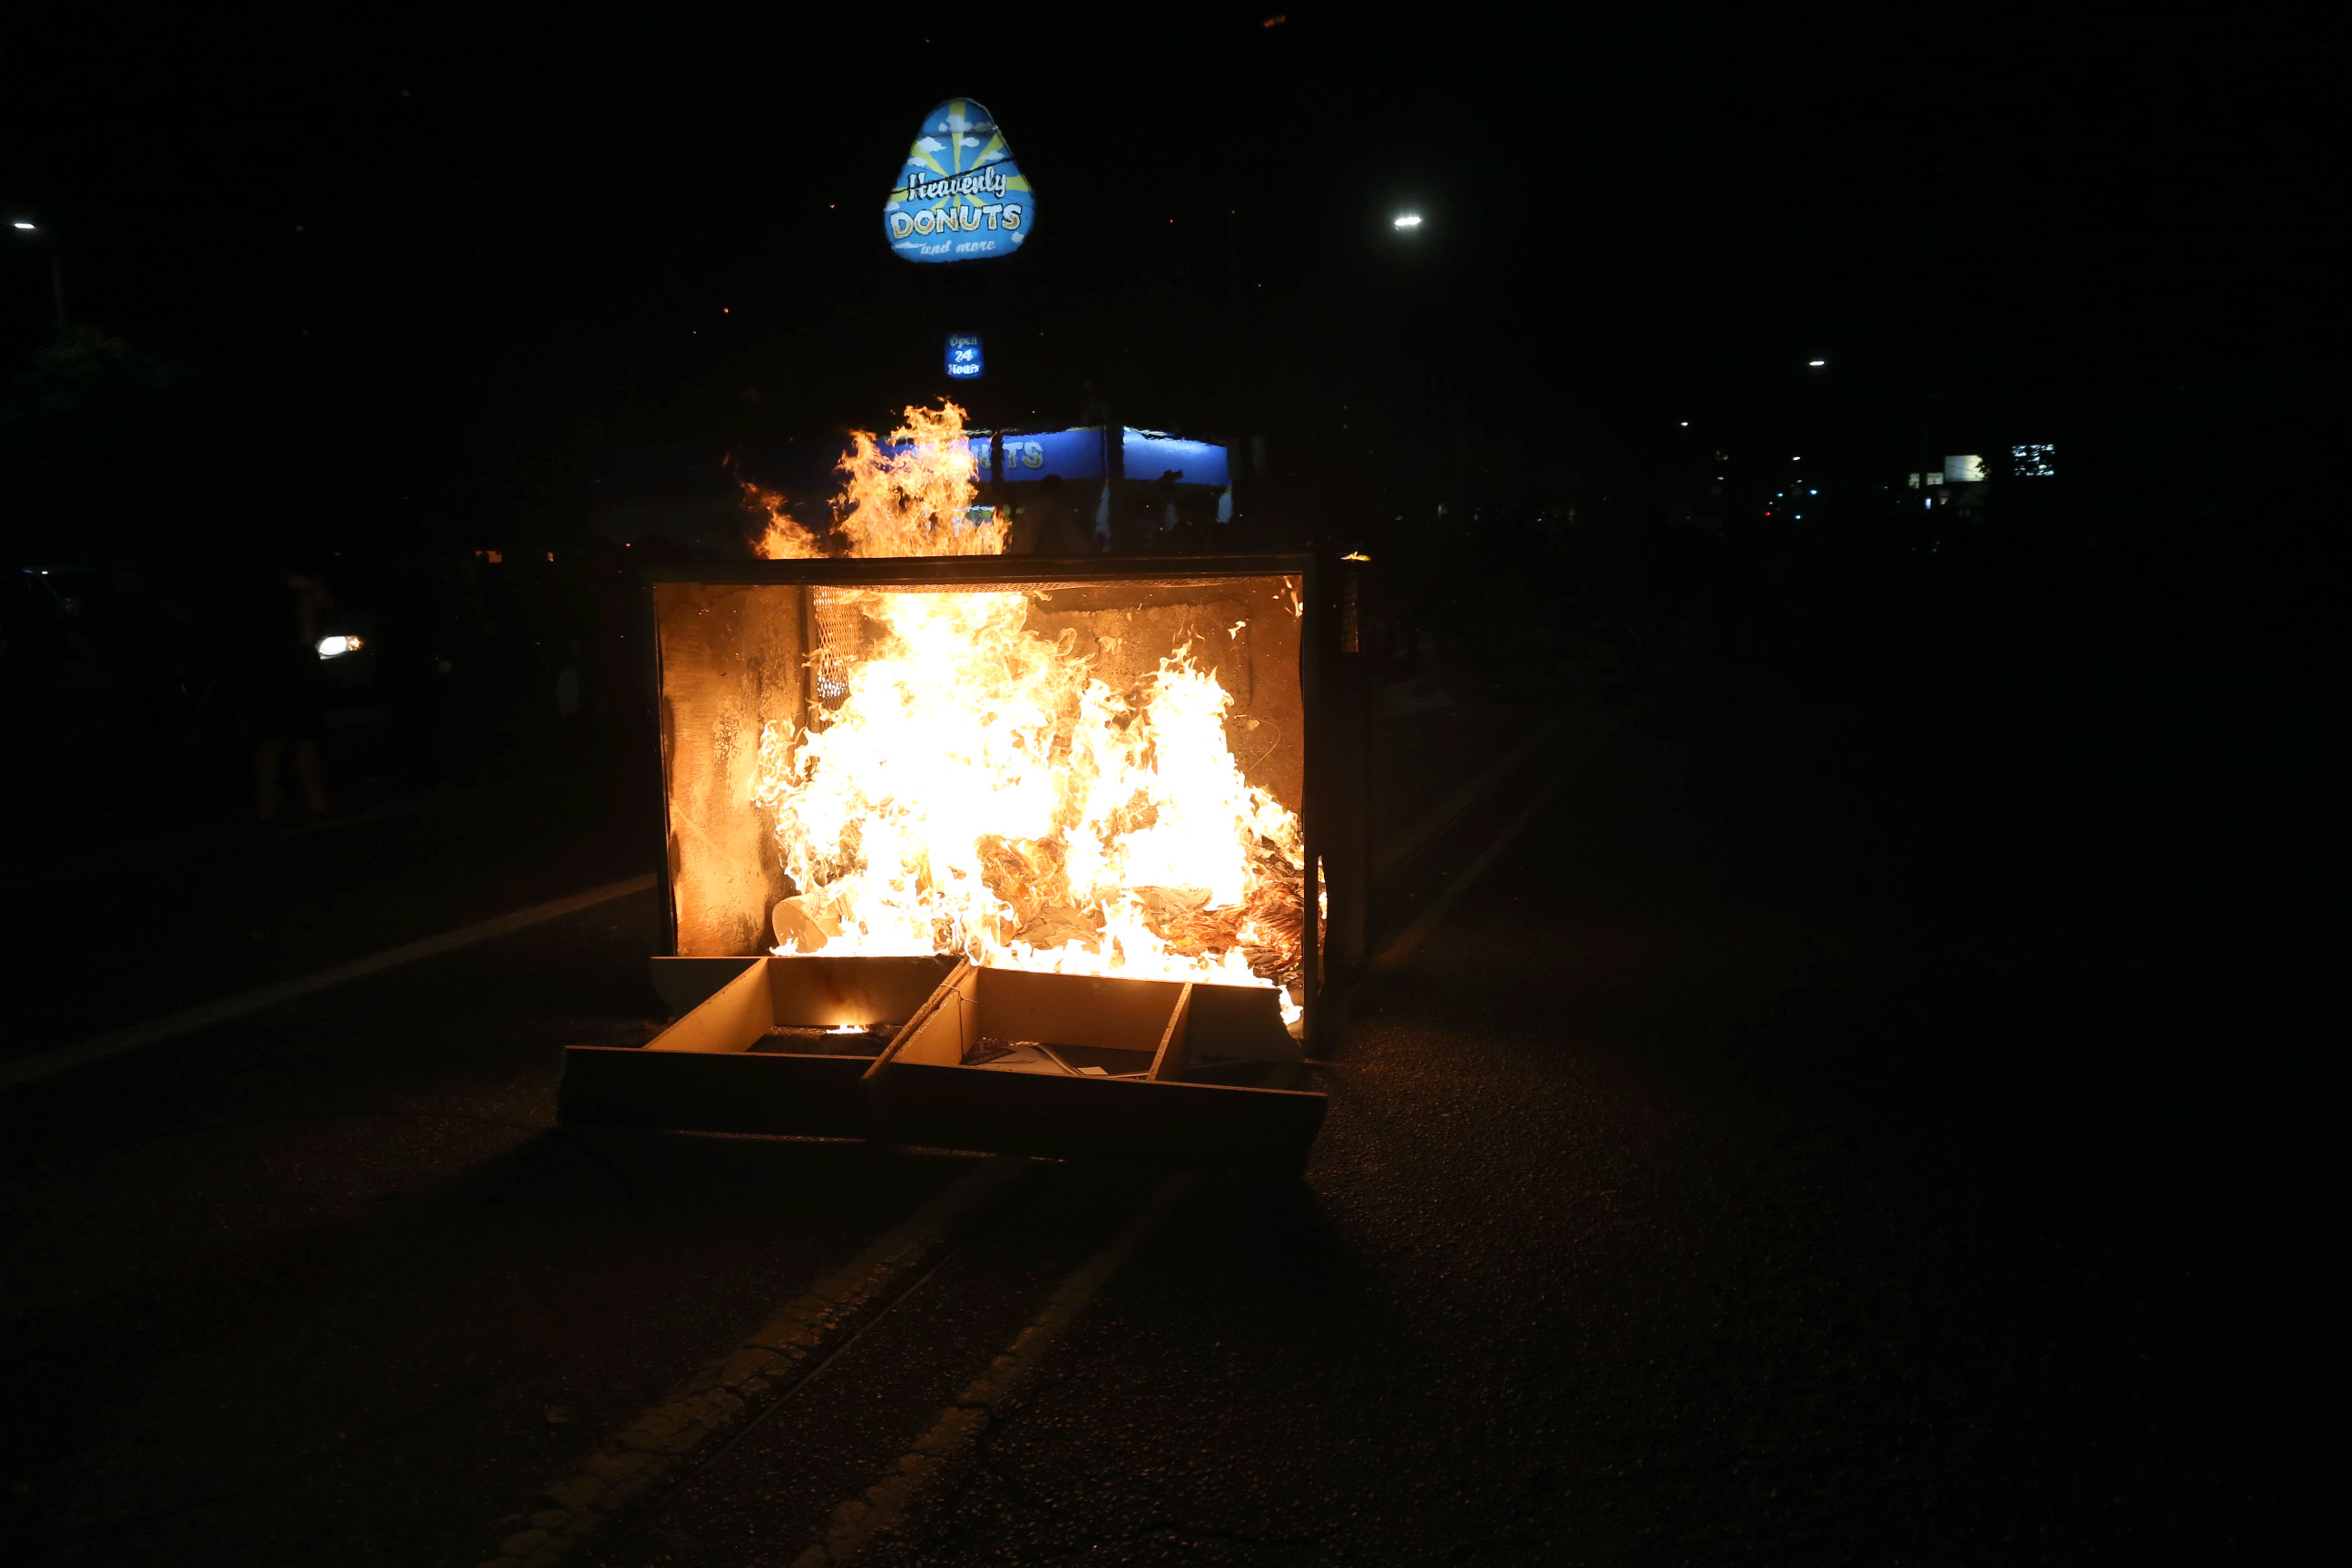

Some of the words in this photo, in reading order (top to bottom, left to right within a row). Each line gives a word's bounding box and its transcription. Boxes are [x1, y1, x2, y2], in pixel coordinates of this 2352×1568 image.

[907, 166, 1006, 201] Heavenly
[890, 204, 1022, 240] DONUTS
[920, 240, 951, 255] and
[956, 240, 995, 253] more
[949, 335, 977, 348] Open
[955, 349, 974, 363] 24
